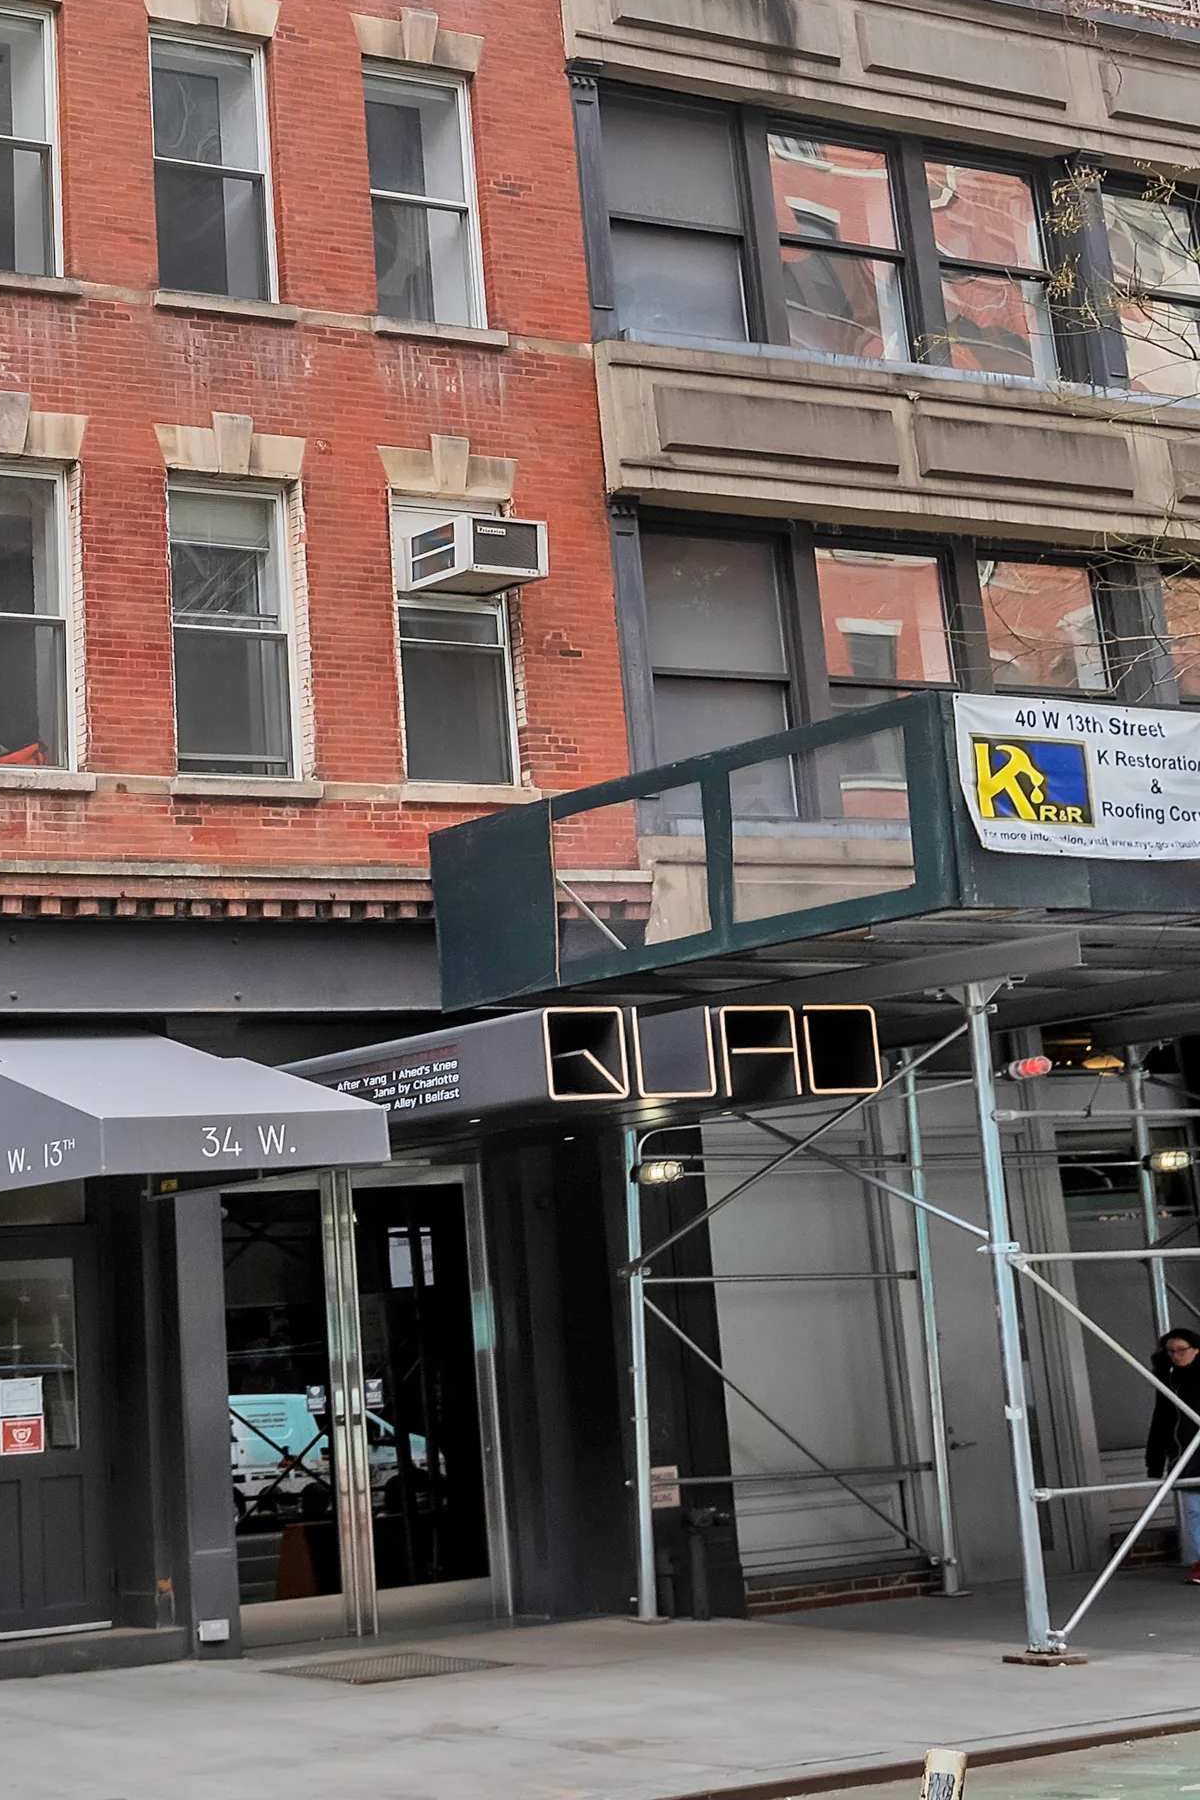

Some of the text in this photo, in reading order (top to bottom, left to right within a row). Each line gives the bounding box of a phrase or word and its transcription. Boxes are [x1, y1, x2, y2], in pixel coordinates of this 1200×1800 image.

[1015, 710, 1166, 738] 40 W 13th Street
[1097, 749, 1200, 773] K Restoratio
[1150, 778, 1163, 795] &
[1039, 804, 1084, 823] R&R
[1102, 801, 1200, 825] Roofing Cor
[1000, 831, 1027, 841] more
[542, 1004, 883, 1100] QUAD
[337, 1079, 361, 1092] After
[363, 1075, 387, 1087] Yang
[399, 1064, 431, 1080] Ahed's
[433, 1060, 458, 1073] Knee
[373, 1073, 460, 1099] Jane by Charlotte
[394, 1097, 417, 1109] Alley
[425, 1087, 460, 1104] Belfast
[202, 1123, 297, 1157] 34 W.
[7, 1146, 32, 1174] W.
[44, 1138, 76, 1168] 13TH
